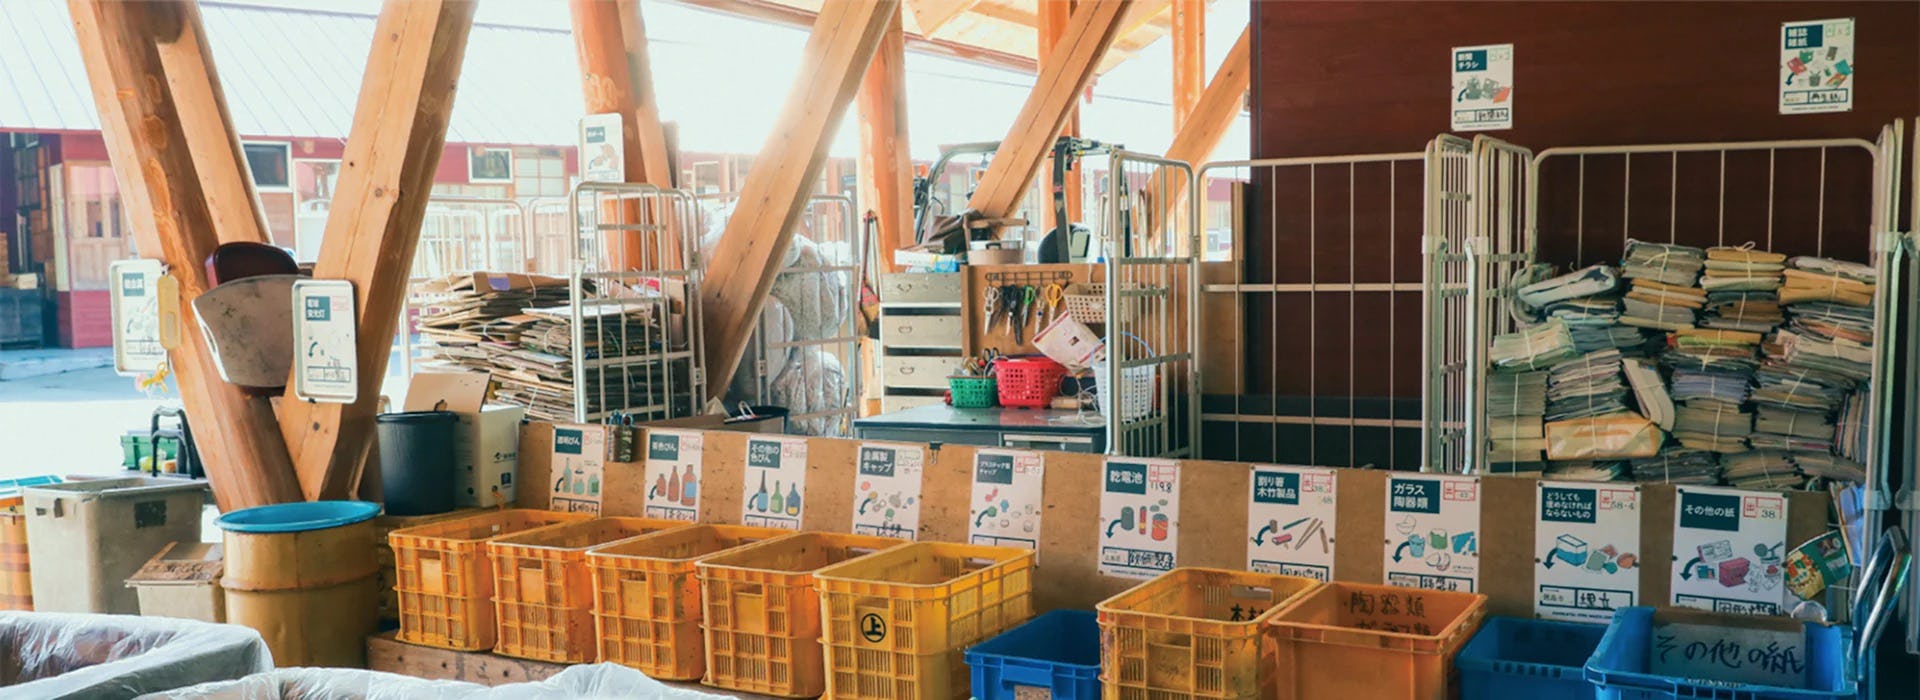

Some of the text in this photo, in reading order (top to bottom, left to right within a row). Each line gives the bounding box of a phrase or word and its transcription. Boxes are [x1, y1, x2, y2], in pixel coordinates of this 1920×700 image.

[1458, 61, 1479, 69] チラシ
[557, 435, 580, 446] 透明びん
[751, 444, 780, 455] その他の
[751, 453, 771, 464] 色びん
[863, 450, 888, 462] 金属製
[863, 461, 892, 473] キャップ
[1110, 470, 1143, 484] 乾電池
[1257, 476, 1285, 487] 割り箸
[1257, 487, 1296, 499] 木竹製品
[1394, 483, 1425, 495] ガラス
[1546, 492, 1580, 501] どうしても
[1393, 496, 1428, 509] 陶器類
[1546, 500, 1592, 510] 埋めなければ
[1546, 509, 1591, 519] ならないもの
[1684, 504, 1735, 518] その他の紙
[1761, 509, 1776, 519] 38
[1656, 634, 1805, 674] その他の紙
